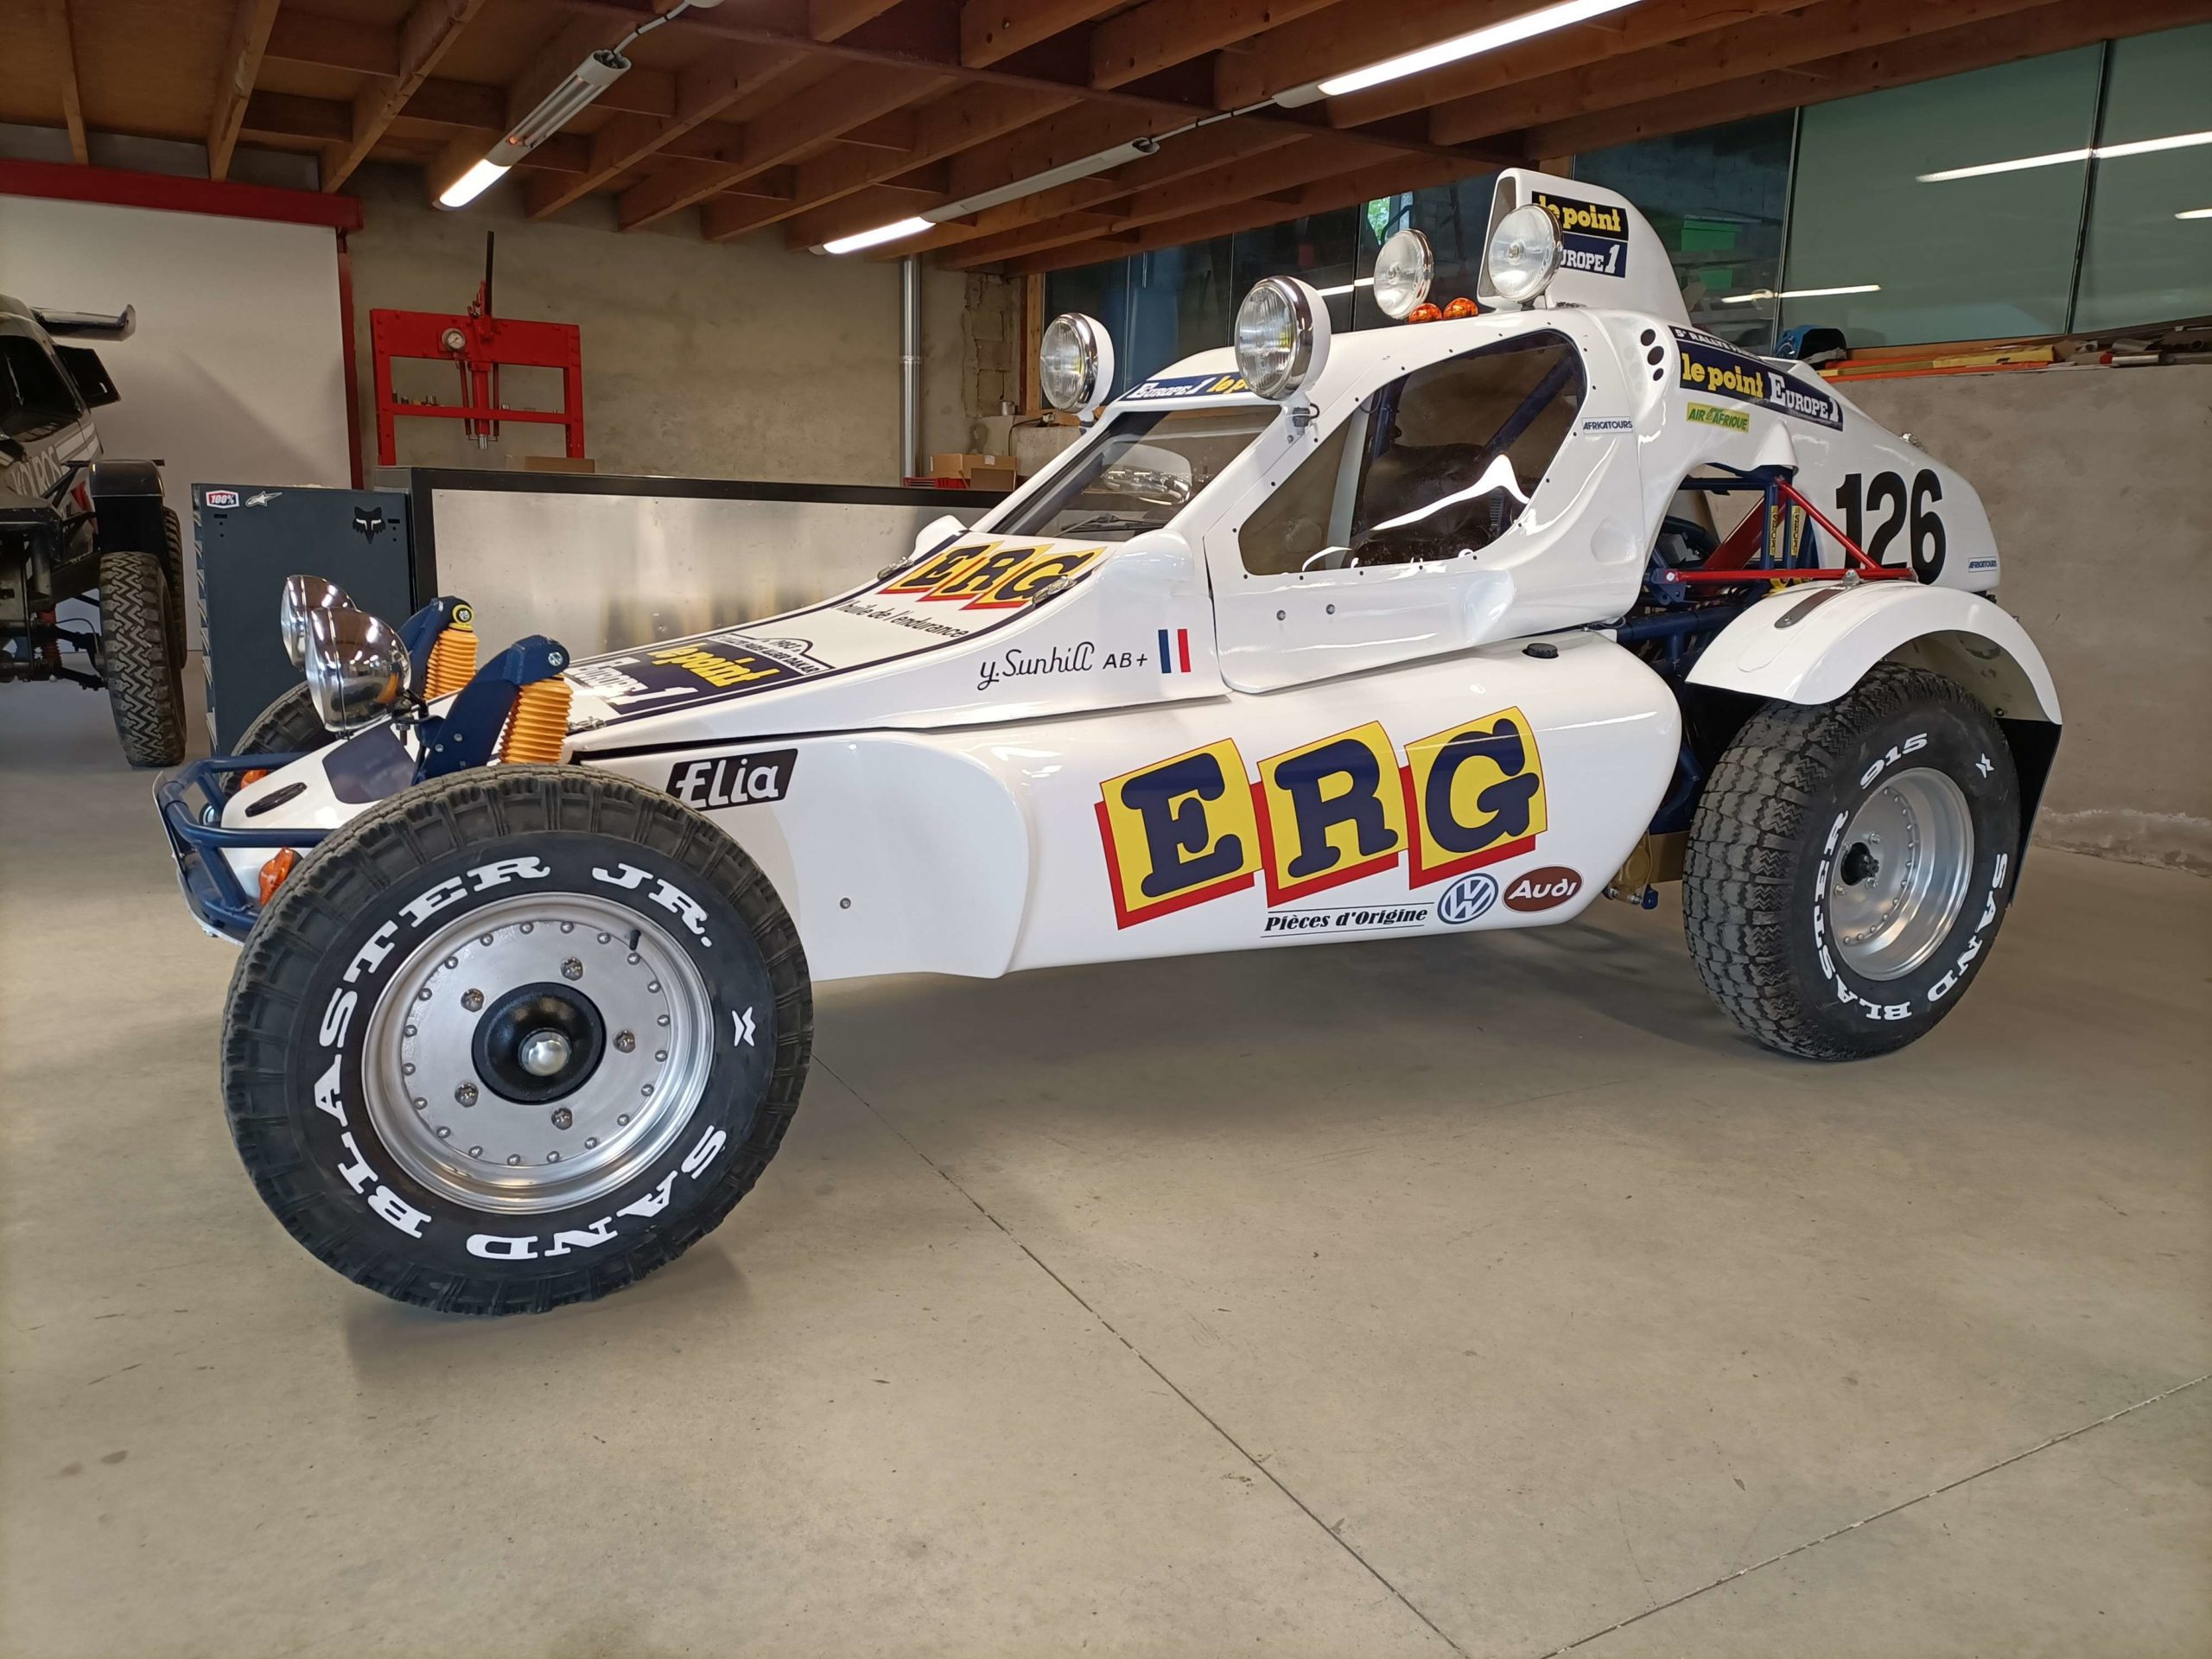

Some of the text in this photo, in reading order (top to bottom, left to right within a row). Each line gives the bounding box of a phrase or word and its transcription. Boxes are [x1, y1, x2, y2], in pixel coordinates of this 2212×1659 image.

[1562, 205, 1621, 232] point
[1559, 244, 1620, 274] UROPE 1
[1688, 332, 1731, 351] RALLYE
[1127, 382, 1193, 399] EUROPE
[1681, 353, 1840, 423] le point EUROPE 1
[1583, 420, 1633, 430] AFRICATOURS
[1688, 408, 1749, 430] AIR AFRIQUE
[210, 494, 235, 505] 100%
[1835, 468, 1947, 585] 126
[899, 543, 1095, 601] ERG
[868, 607, 895, 620] de
[883, 610, 969, 638] l'endurance
[652, 651, 781, 688] point
[1859, 732, 1928, 791] 915
[1121, 718, 1540, 898] ERG
[1508, 880, 1577, 900] Audi
[1264, 908, 1427, 932] Pièces d'Origine
[1814, 810, 2009, 1021] SAND BLASTER
[315, 855, 728, 1260] SAND BLASTER JR.
